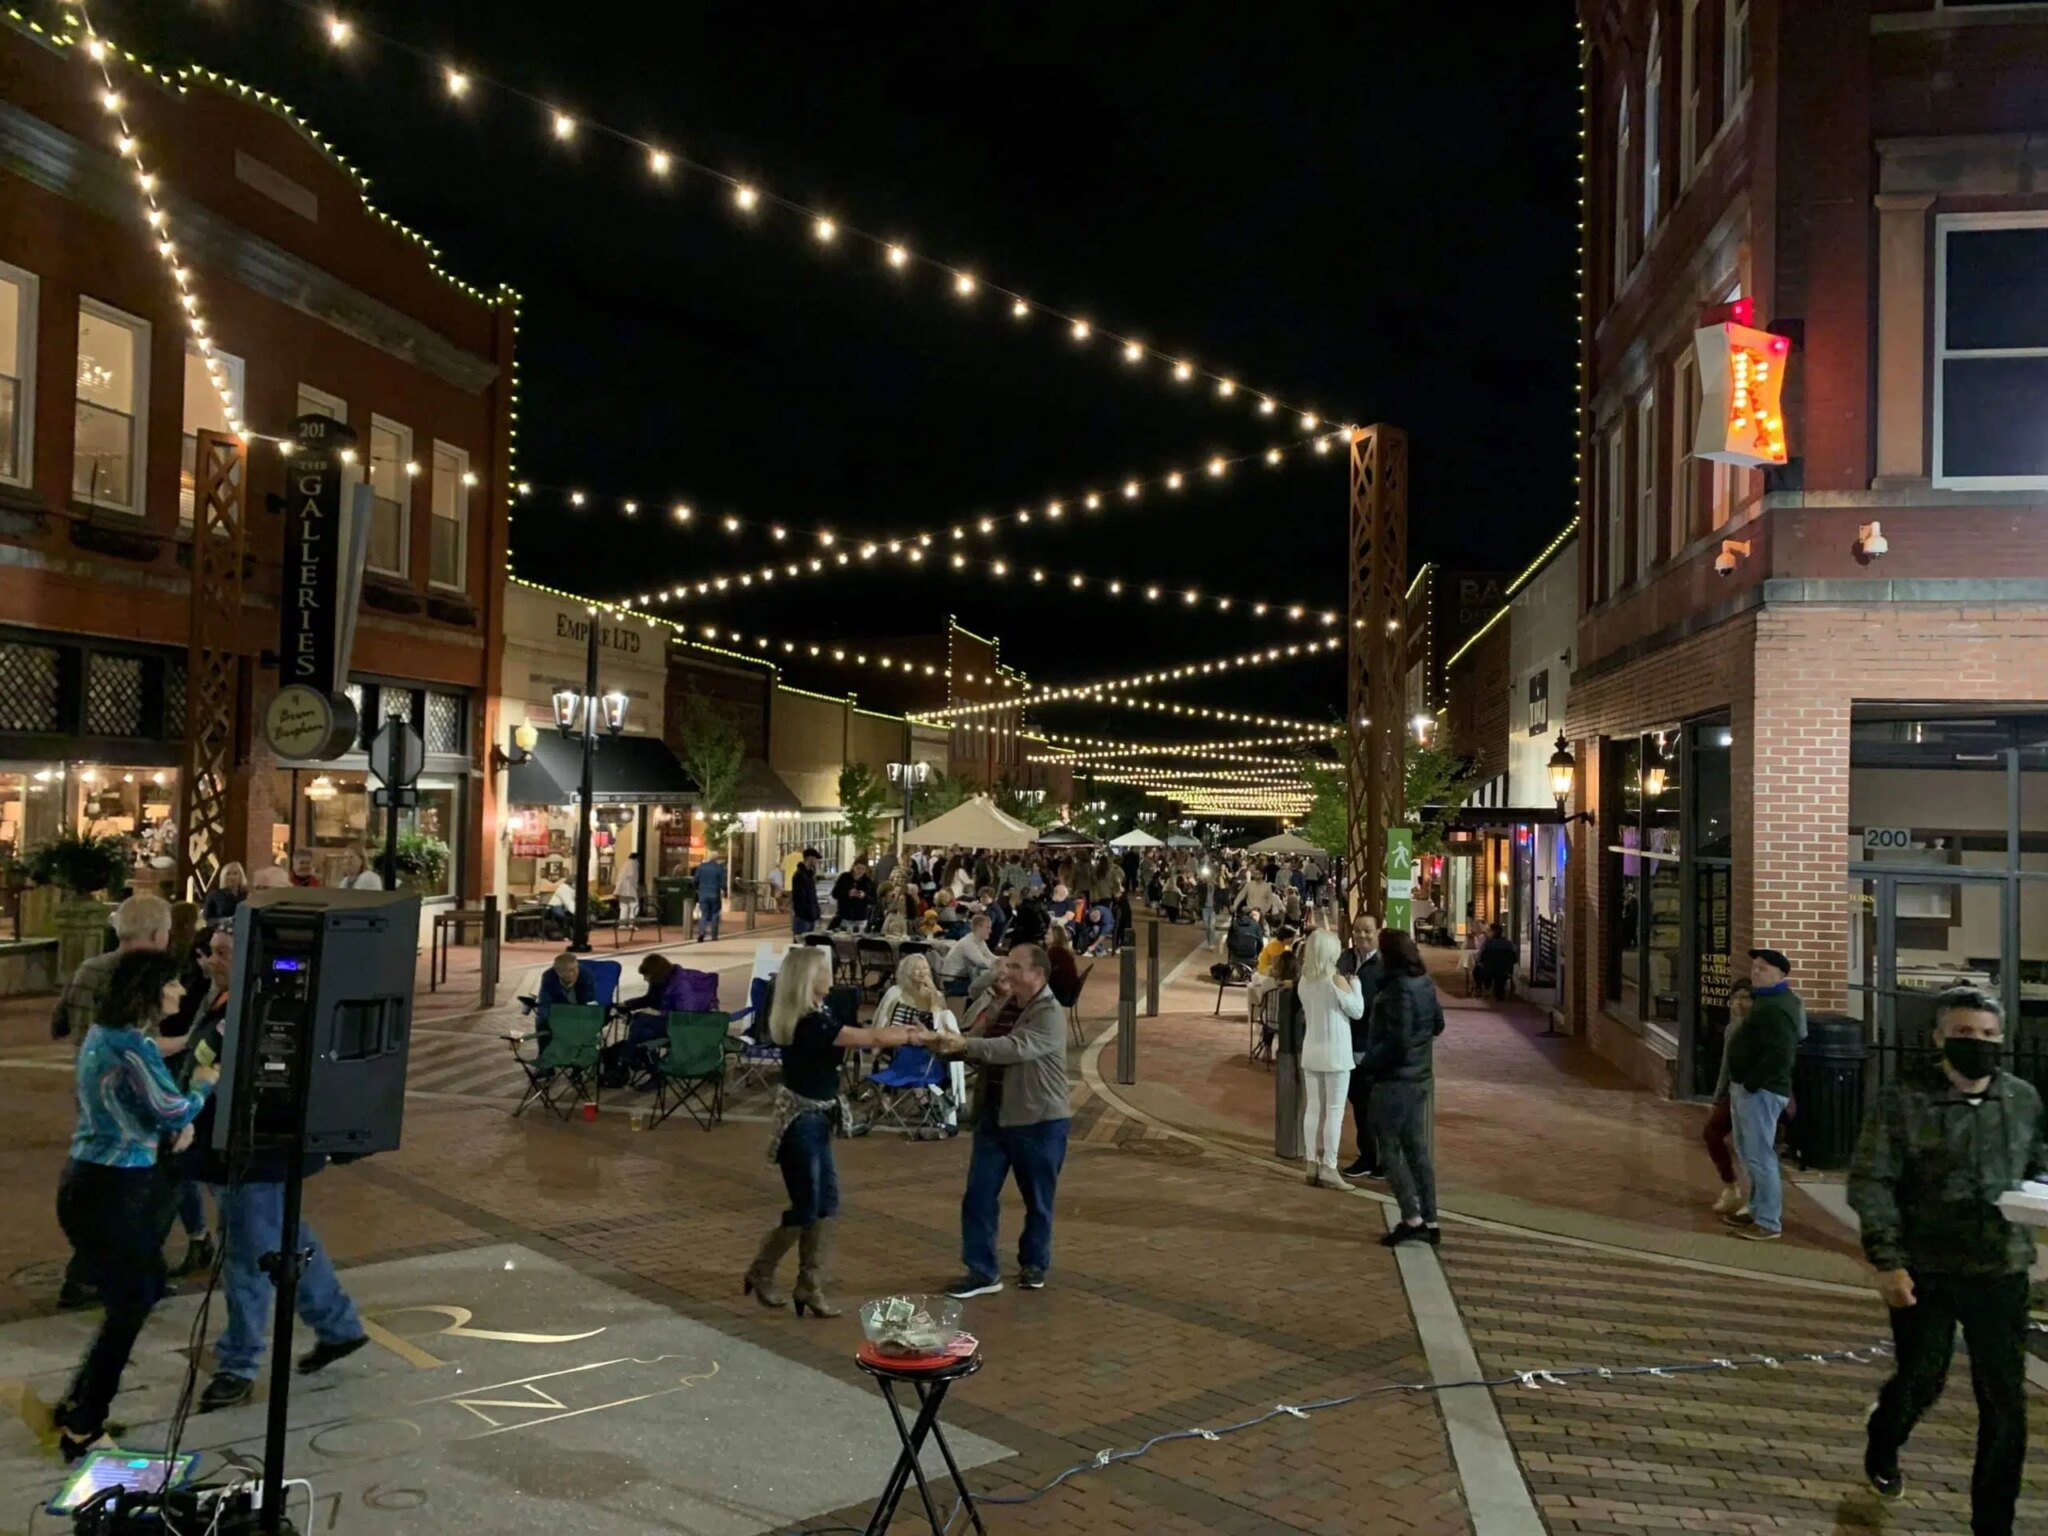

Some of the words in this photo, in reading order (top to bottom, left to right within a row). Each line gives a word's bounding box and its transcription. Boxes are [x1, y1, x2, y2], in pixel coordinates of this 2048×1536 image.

[299, 422, 326, 438] 201
[295, 475, 323, 676] GALLERIES
[557, 613, 611, 646] EMPE
[1867, 829, 1908, 848] 200
[1701, 996, 1725, 1006] FREE
